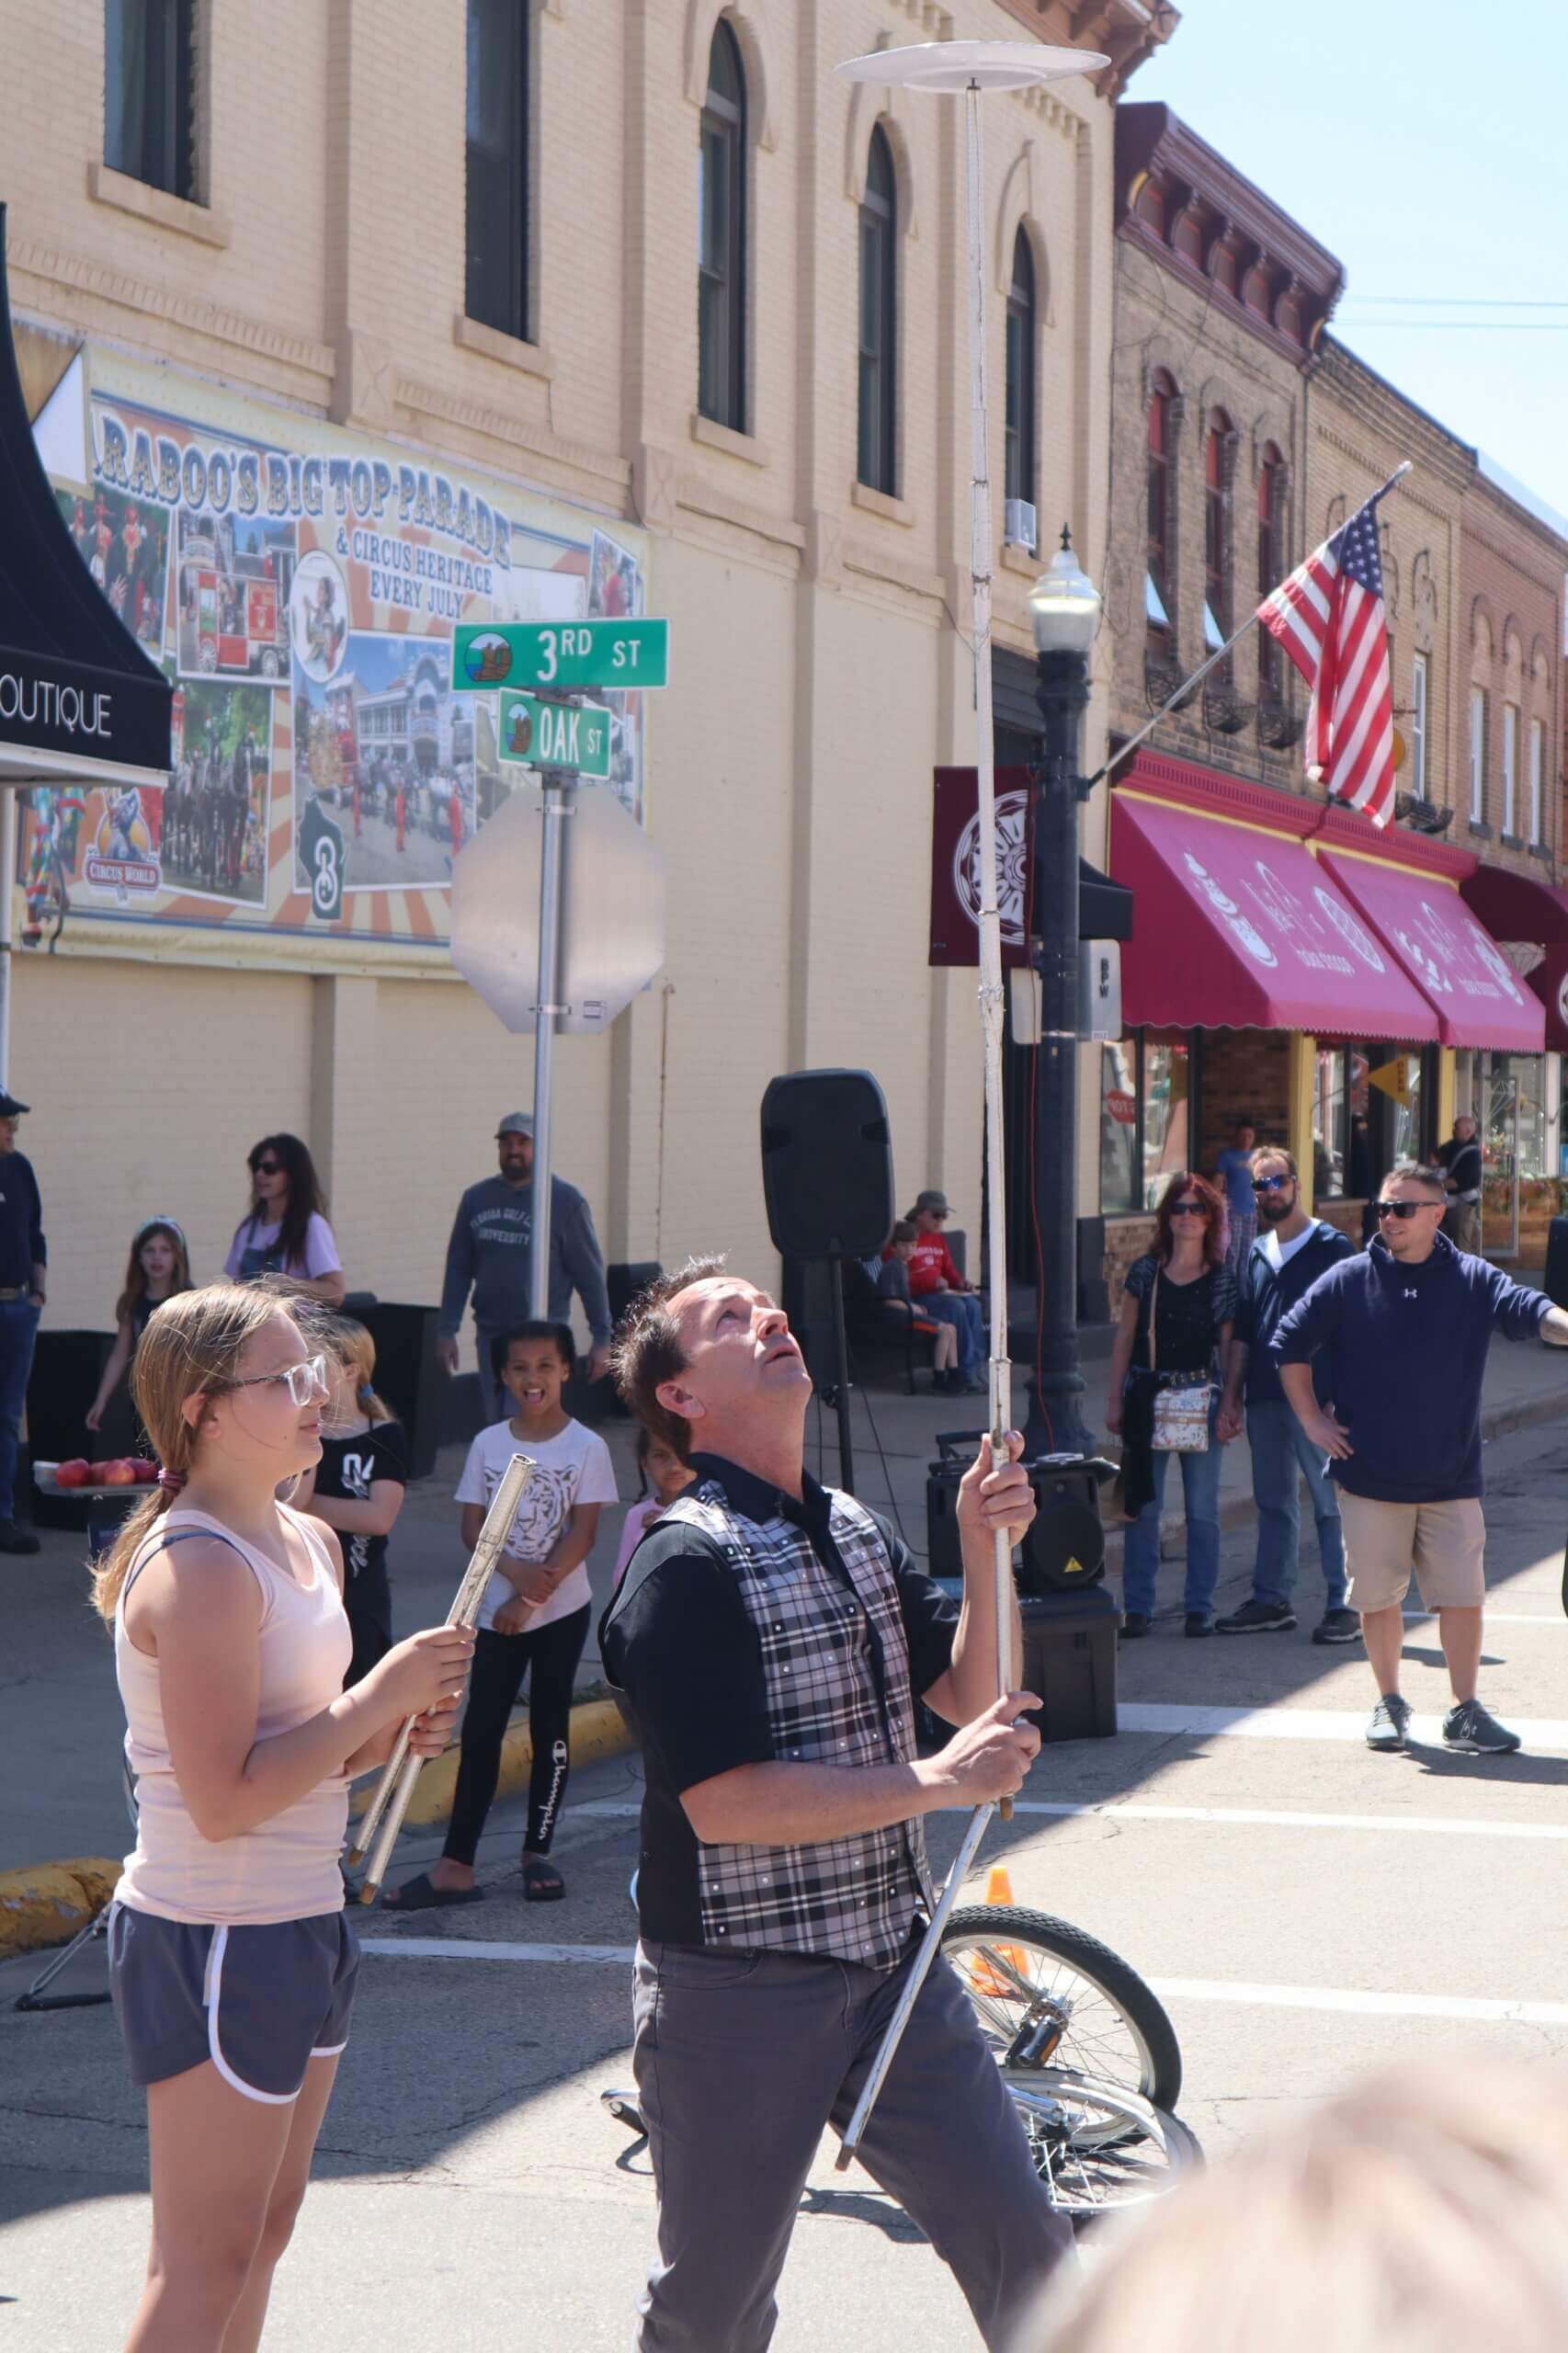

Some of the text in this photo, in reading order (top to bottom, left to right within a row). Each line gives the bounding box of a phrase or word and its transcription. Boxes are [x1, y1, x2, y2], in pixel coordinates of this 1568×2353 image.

[94, 415, 258, 515] RABOO'S
[267, 455, 324, 517] BIG
[336, 527, 493, 595] & CIRCUS HERITAGE
[370, 570, 463, 620] EVERY JULY
[537, 629, 642, 681] 3RD ST
[0, 674, 111, 737] OUTIQUE
[540, 707, 603, 764] OAK ST
